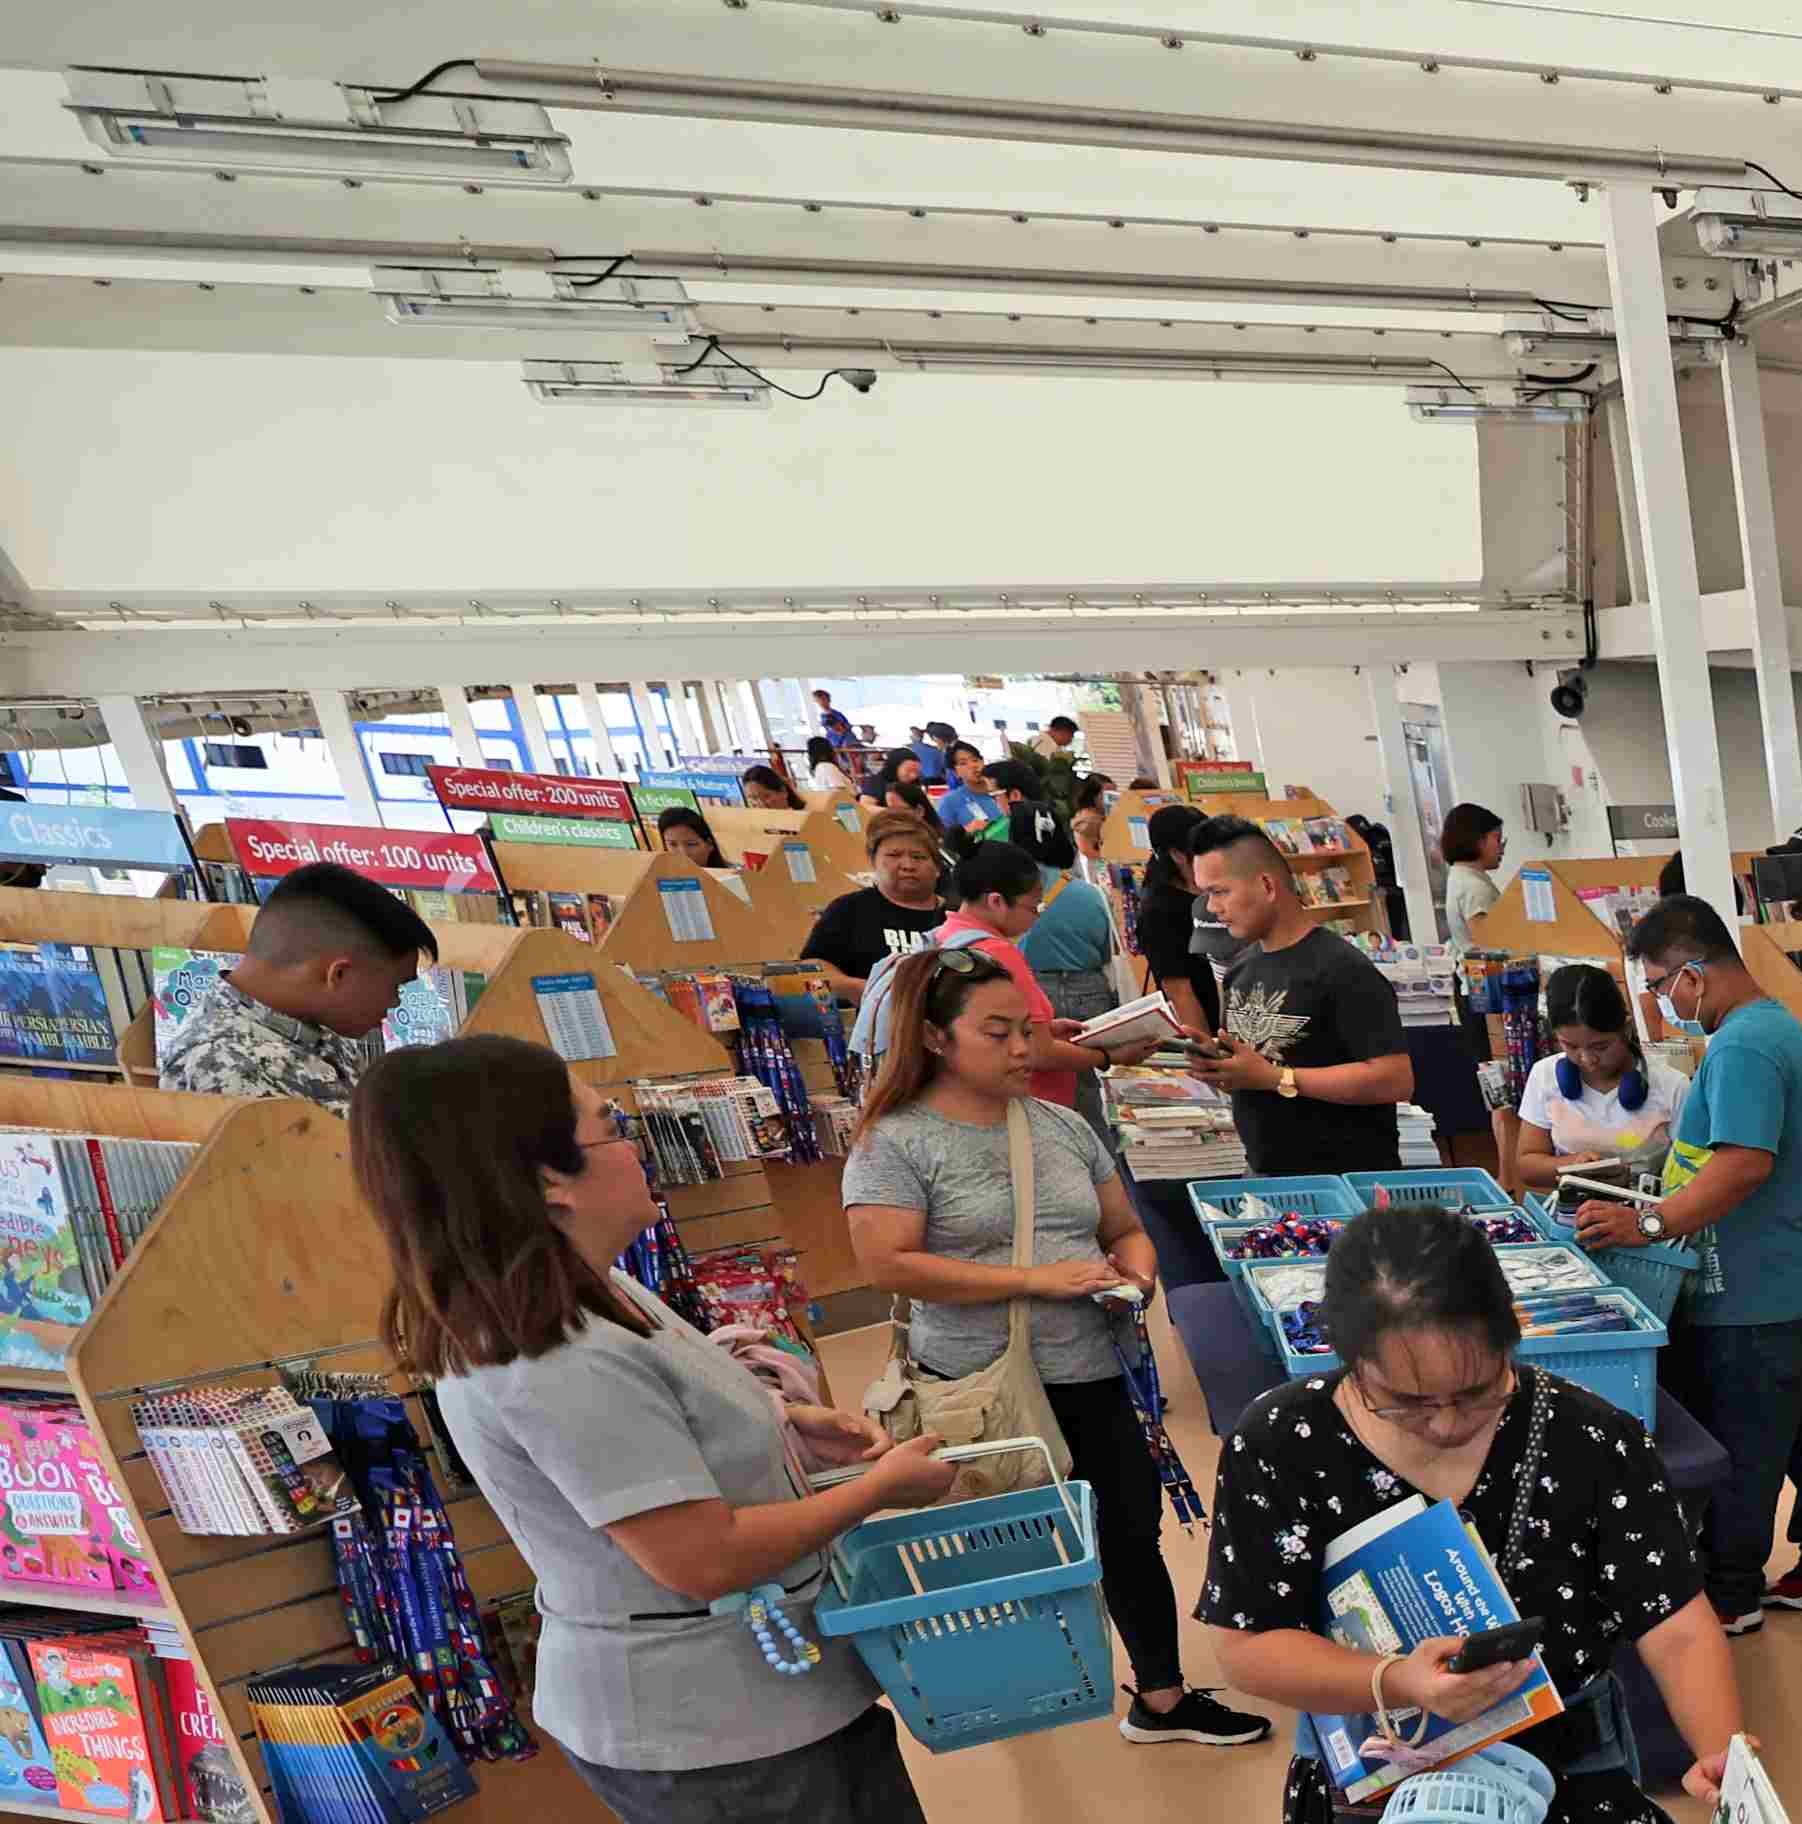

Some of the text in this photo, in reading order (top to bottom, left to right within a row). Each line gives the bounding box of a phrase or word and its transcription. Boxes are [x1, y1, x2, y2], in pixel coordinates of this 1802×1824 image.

[446, 776, 620, 810] Special offer: 200 units
[9, 815, 113, 850] Classics
[502, 816, 624, 841] Children's classics
[248, 835, 477, 874] Special offer: 100 units
[1446, 1547, 1503, 1631] Around the W
[1454, 1590, 1476, 1622] With
[51, 1709, 119, 1734] INCREDIBLE
[180, 1711, 224, 1740] CREA
[79, 1733, 146, 1760] THINGS
